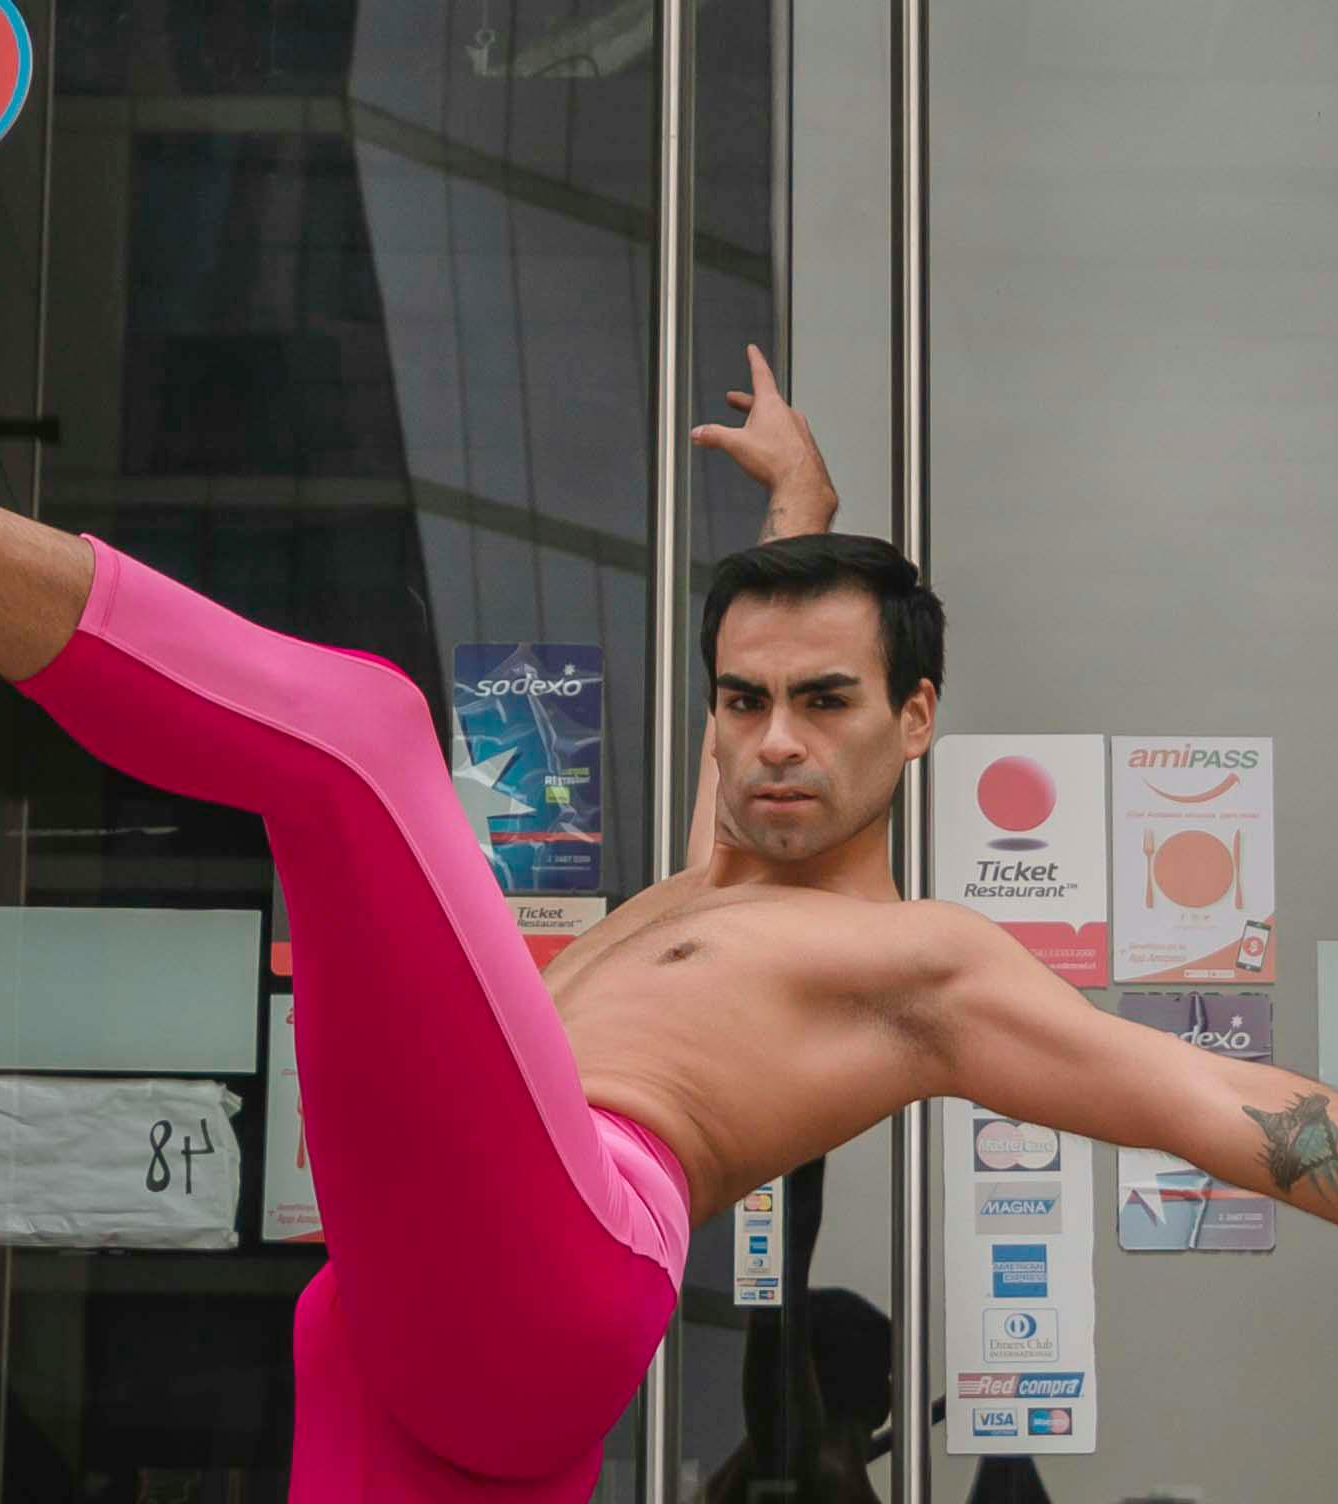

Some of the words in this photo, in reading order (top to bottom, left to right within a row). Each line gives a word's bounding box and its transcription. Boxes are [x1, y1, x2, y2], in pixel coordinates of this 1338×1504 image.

[474, 671, 583, 698] sodexo
[1127, 743, 1260, 769] amiPASS
[976, 860, 1059, 882] Ticket
[516, 906, 564, 920] Ticket
[1168, 1023, 1252, 1051] dexo
[981, 1199, 1047, 1214] MAGNA
[980, 1412, 1014, 1426] VISA
